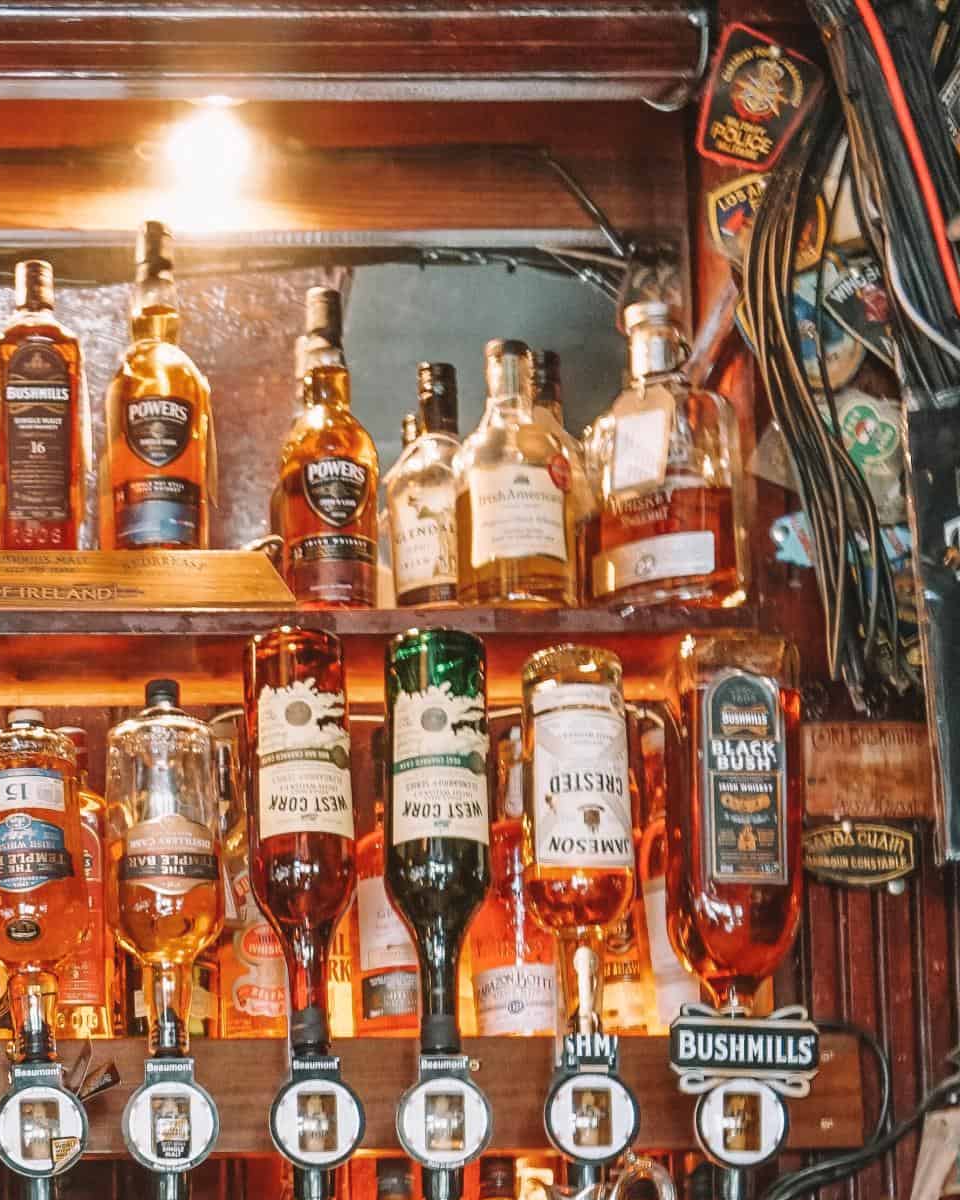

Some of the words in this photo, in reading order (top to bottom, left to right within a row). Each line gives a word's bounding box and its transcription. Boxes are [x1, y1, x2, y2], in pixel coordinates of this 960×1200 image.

[6, 387, 69, 400] BUSHMILLS
[129, 400, 188, 421] POWERS
[308, 461, 365, 482] POWERS
[19, 585, 116, 600] IRELAND
[721, 711, 768, 726] BUSHMILLS
[712, 739, 776, 758] BLACK
[717, 754, 771, 771] BUSH
[6, 784, 28, 800] 15
[550, 772, 623, 797] CRESTED
[268, 794, 308, 812] CORK
[313, 794, 349, 812] WEST
[401, 800, 441, 818] CORK
[447, 800, 483, 818] WEST
[548, 836, 630, 854] JAMESON
[8, 853, 65, 865] TEMPLE
[8, 864, 32, 873] THE
[161, 865, 185, 875] THE
[678, 1029, 815, 1065] BUSHMILLS
[14, 1066, 60, 1077] Beaumont
[146, 1062, 192, 1072] Beaumont
[293, 1059, 338, 1069] Beaumont
[421, 1059, 466, 1069] Beaumont
